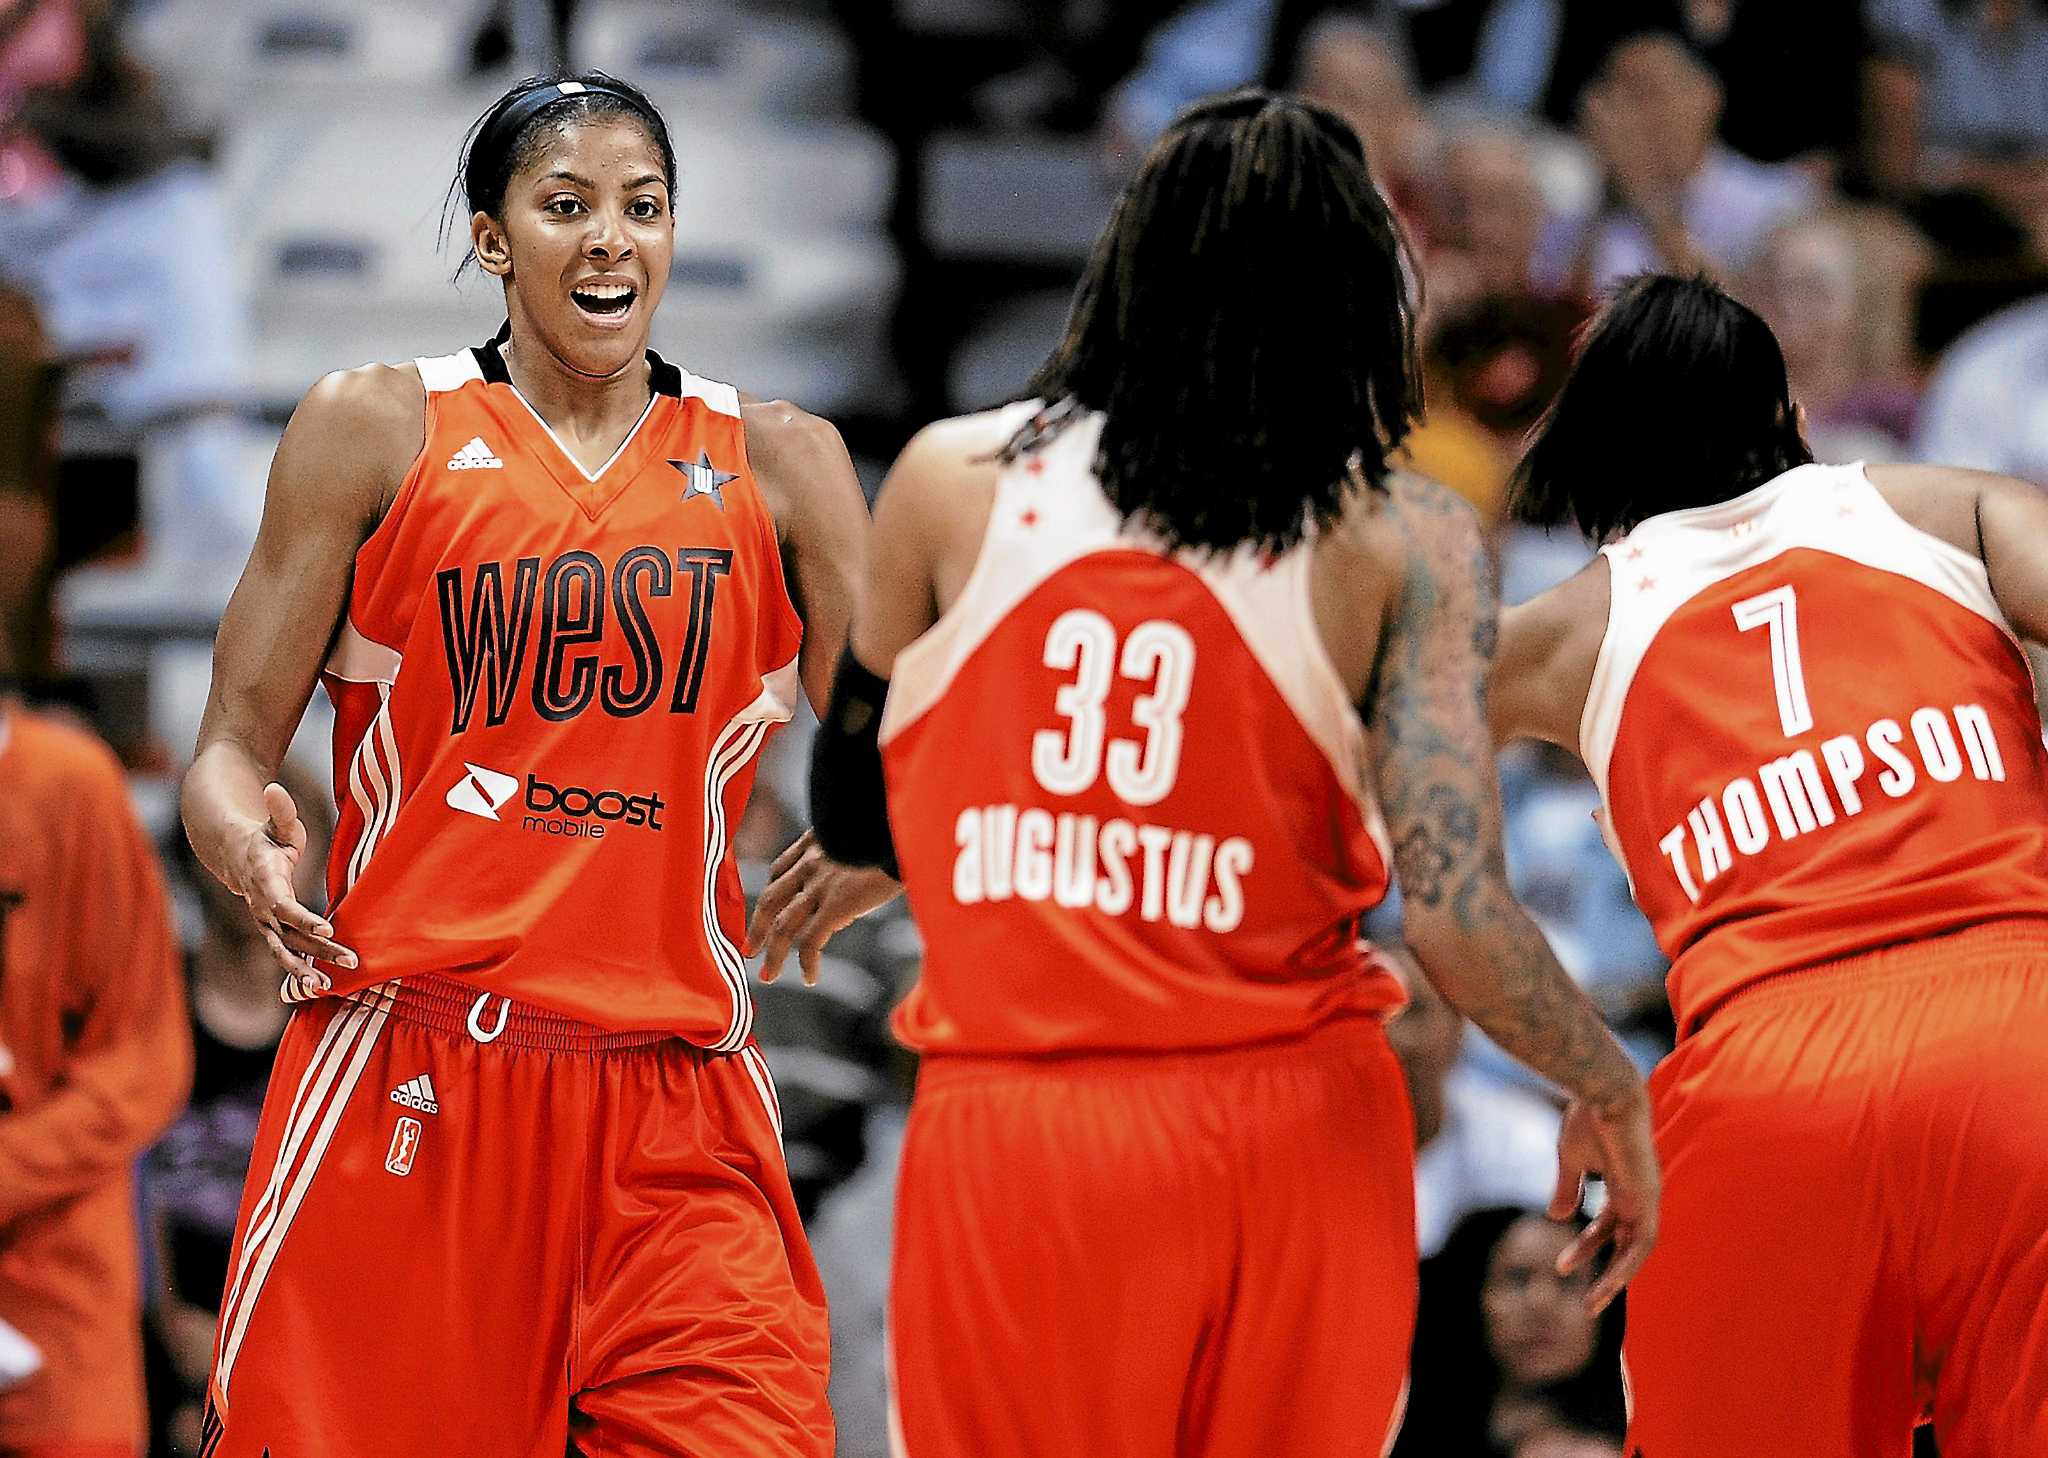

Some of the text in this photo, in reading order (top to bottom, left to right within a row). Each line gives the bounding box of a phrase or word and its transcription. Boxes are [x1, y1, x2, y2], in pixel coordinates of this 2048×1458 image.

[1730, 584, 1813, 738] 7
[1031, 609, 1196, 807] 33
[522, 816, 605, 839] mobile
[526, 773, 665, 831] boost
[389, 1090, 439, 1114] adidas
